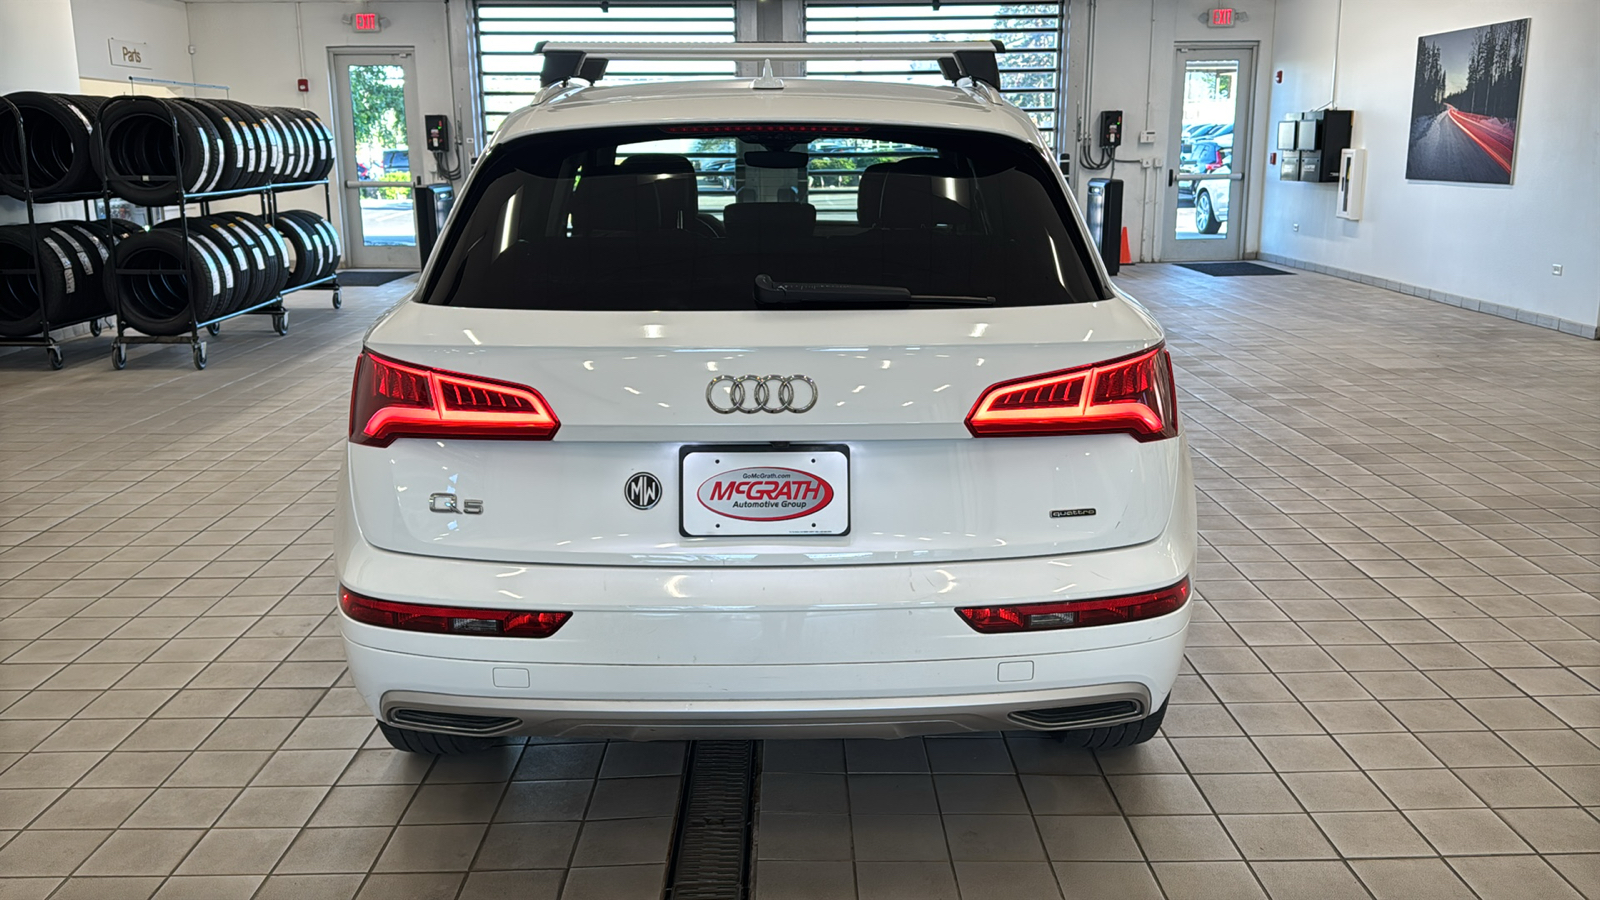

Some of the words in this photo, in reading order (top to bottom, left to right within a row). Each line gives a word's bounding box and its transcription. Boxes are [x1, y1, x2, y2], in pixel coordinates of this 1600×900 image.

[355, 13, 376, 30] EXIT
[1212, 8, 1233, 25] EXIT
[122, 46, 142, 63] Parts
[631, 476, 656, 506] MW
[428, 492, 484, 515] Q5
[732, 500, 779, 509] Automotive
[781, 500, 807, 510] Group
[1052, 509, 1095, 518] quattro
